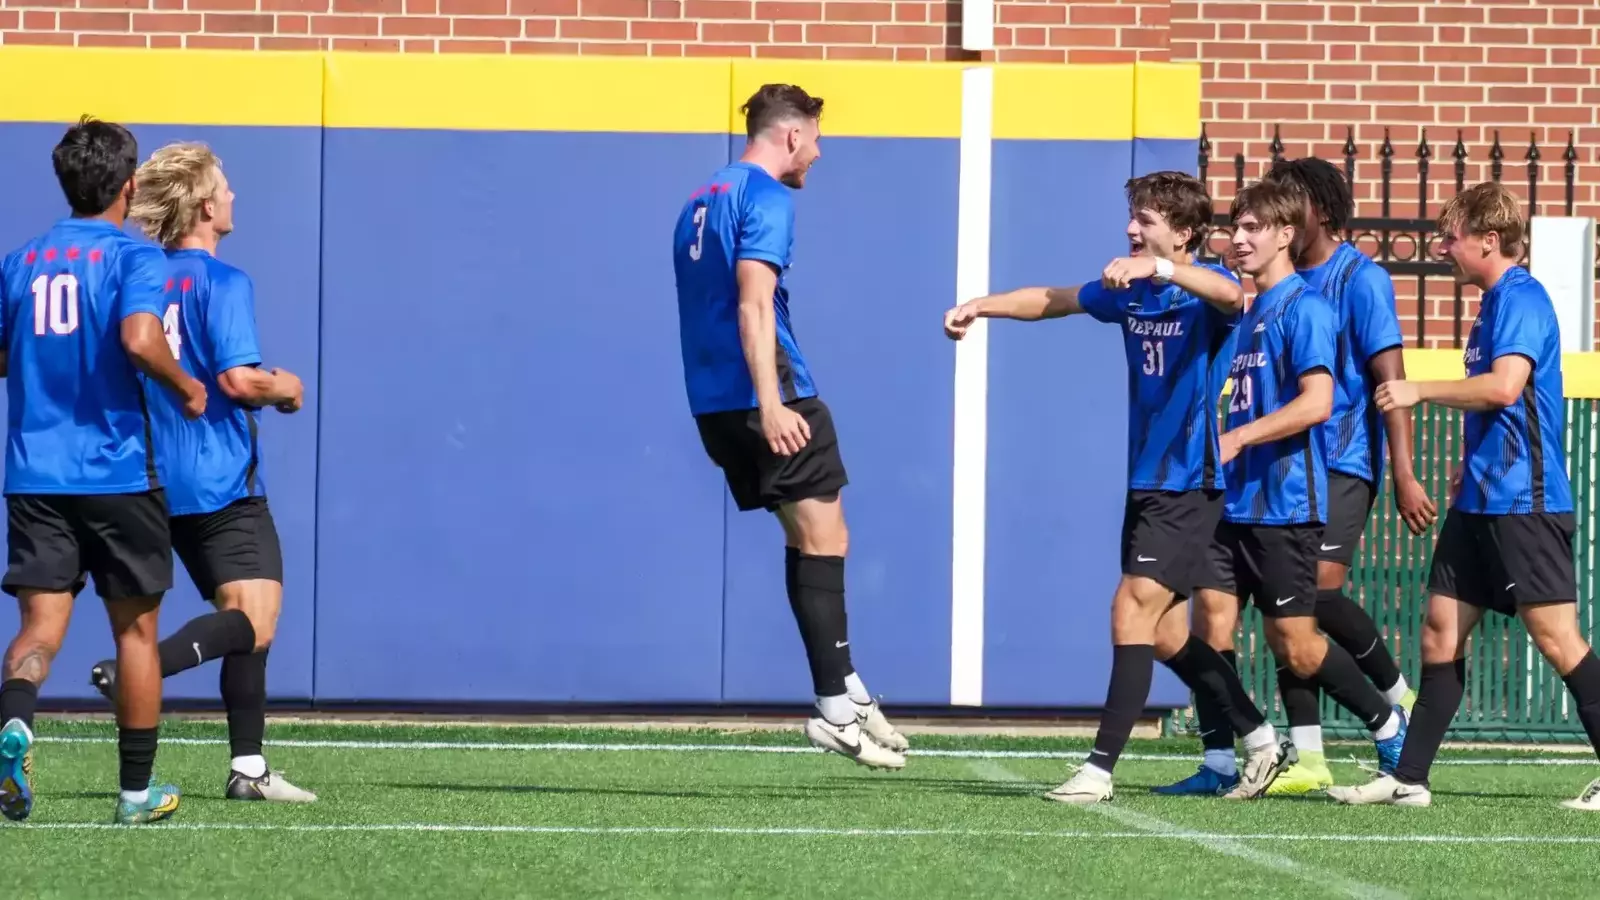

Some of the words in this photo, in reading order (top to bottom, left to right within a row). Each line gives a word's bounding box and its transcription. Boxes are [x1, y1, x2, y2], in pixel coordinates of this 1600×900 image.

[689, 206, 707, 261] 3
[32, 274, 79, 335] 10
[1142, 341, 1164, 376] 31
[1229, 375, 1252, 413] 29
